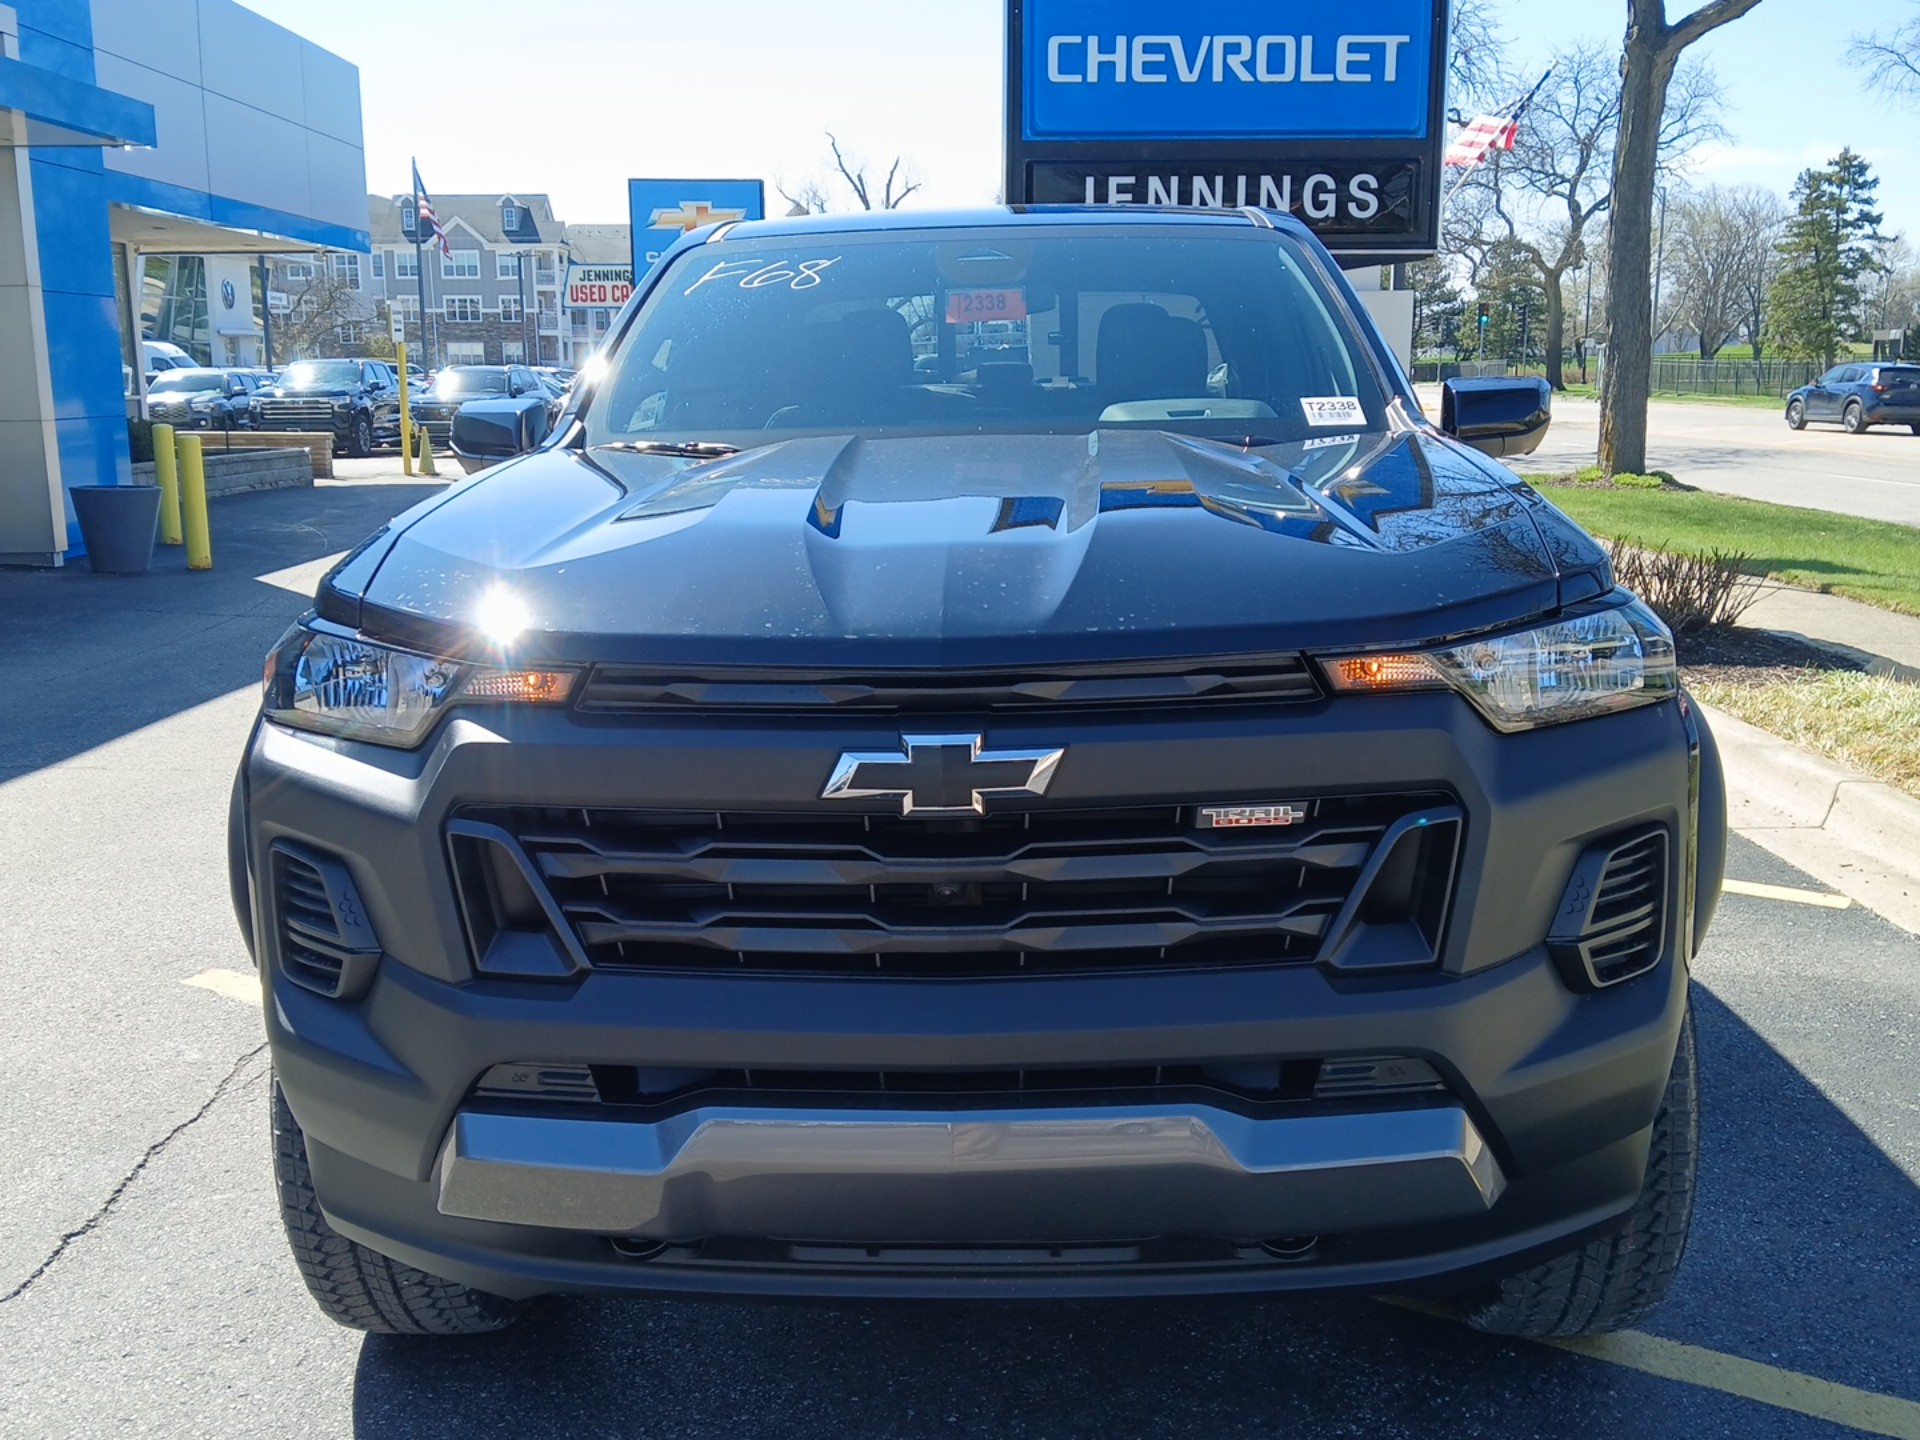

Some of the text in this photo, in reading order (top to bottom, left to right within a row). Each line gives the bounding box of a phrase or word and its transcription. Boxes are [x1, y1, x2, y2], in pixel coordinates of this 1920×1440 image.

[1047, 35, 1410, 83] CHEVROLET
[683, 255, 842, 296] F68
[570, 284, 635, 302] USED CA
[1305, 401, 1356, 411] T2338
[1202, 806, 1303, 819] TRAIL
